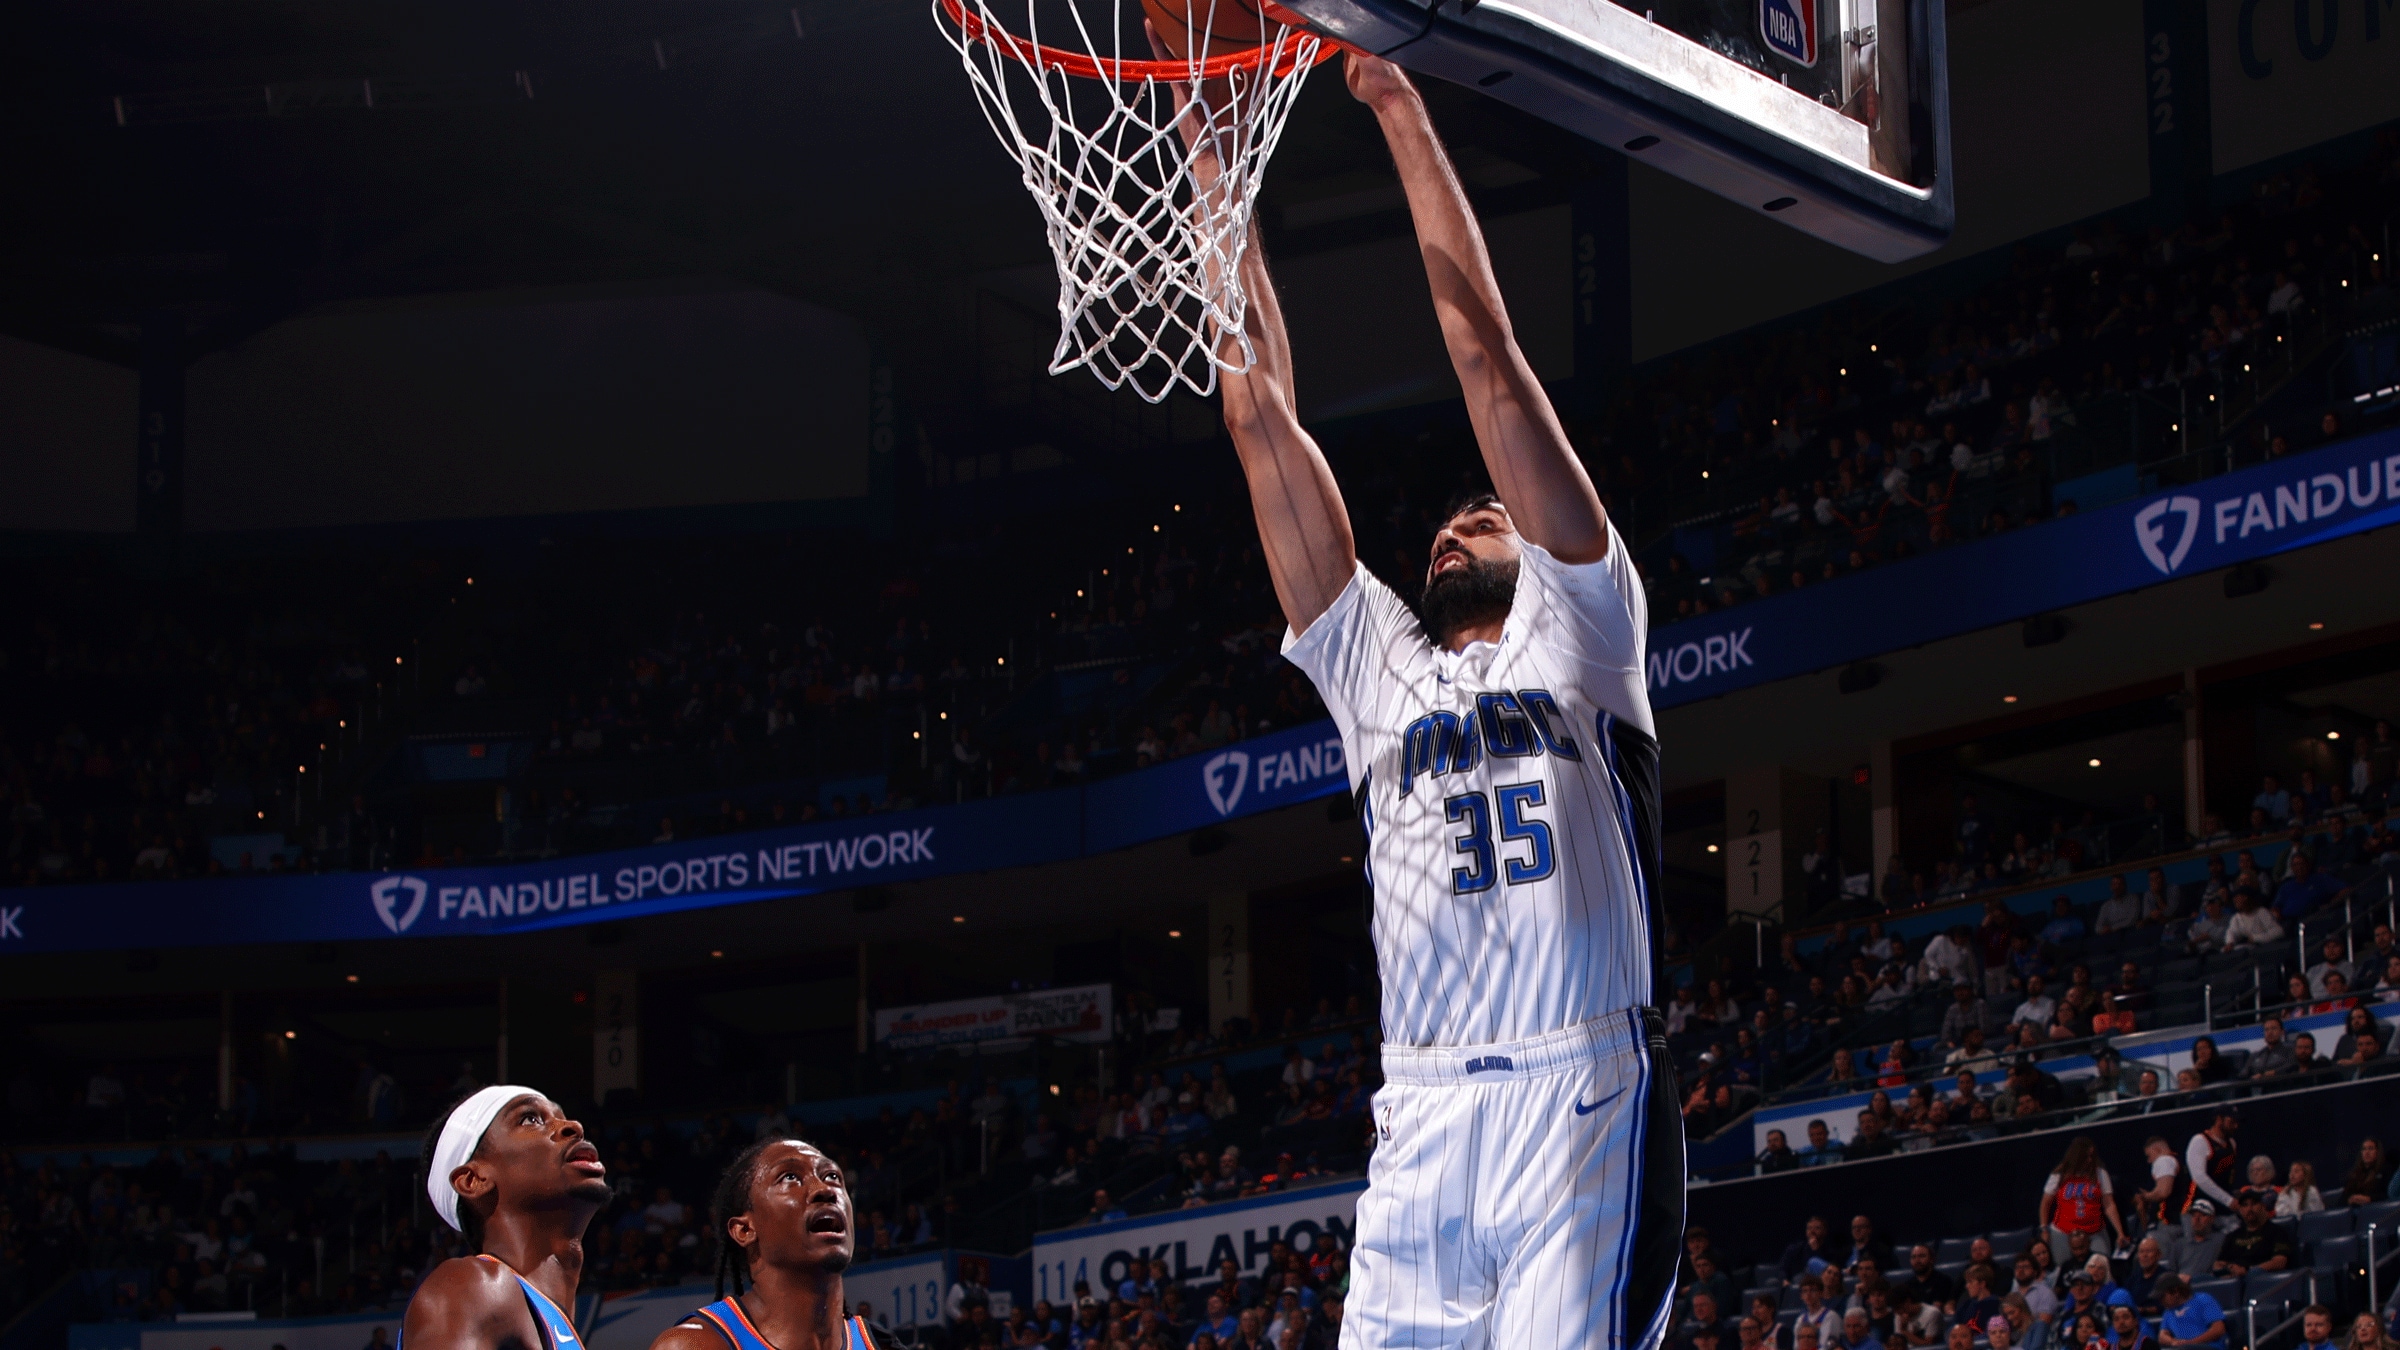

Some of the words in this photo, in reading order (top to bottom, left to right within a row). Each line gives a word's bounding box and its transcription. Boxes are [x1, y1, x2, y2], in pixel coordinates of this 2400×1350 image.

[1769, 6, 1797, 48] NBA
[2150, 31, 2174, 134] 322
[1578, 233, 1597, 325] 321
[872, 365, 894, 453] 320
[145, 411, 166, 494] 319
[438, 873, 608, 920] FANDUEL
[615, 853, 748, 902] SPORTS
[758, 827, 934, 882] NETWORK
[1444, 780, 1556, 896] 35
[1748, 808, 1761, 895] 221
[1222, 924, 1234, 1002] 221
[608, 994, 622, 1067] 220
[982, 1009, 1008, 1023] UP
[1015, 1007, 1081, 1028] PAINT
[1465, 1056, 1514, 1075] ORLANDO
[892, 1280, 938, 1323] 113
[1038, 1257, 1087, 1300] 114
